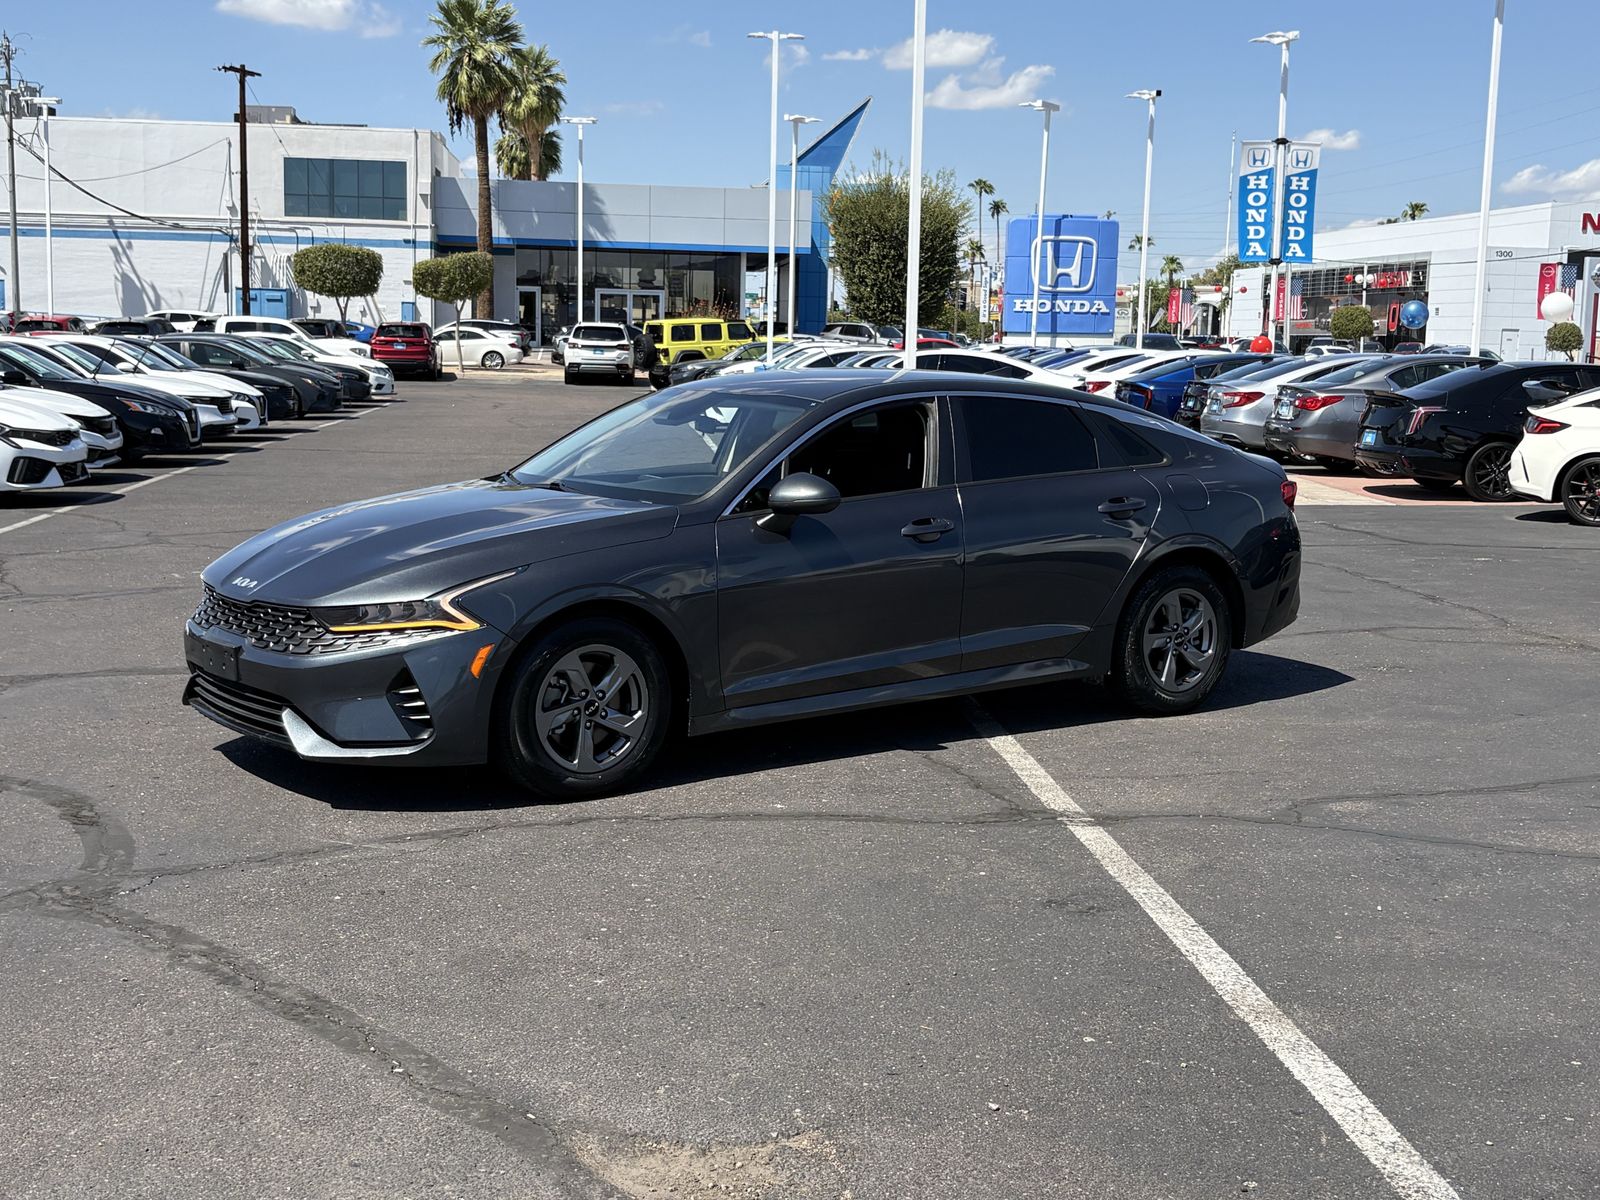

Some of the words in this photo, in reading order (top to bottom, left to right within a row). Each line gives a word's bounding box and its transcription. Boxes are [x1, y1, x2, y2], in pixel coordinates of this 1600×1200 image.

[1246, 175, 1268, 256] HONDA
[1286, 176, 1310, 257] HONDA
[1495, 250, 1514, 258] 1300
[1013, 299, 1110, 314] HONDA
